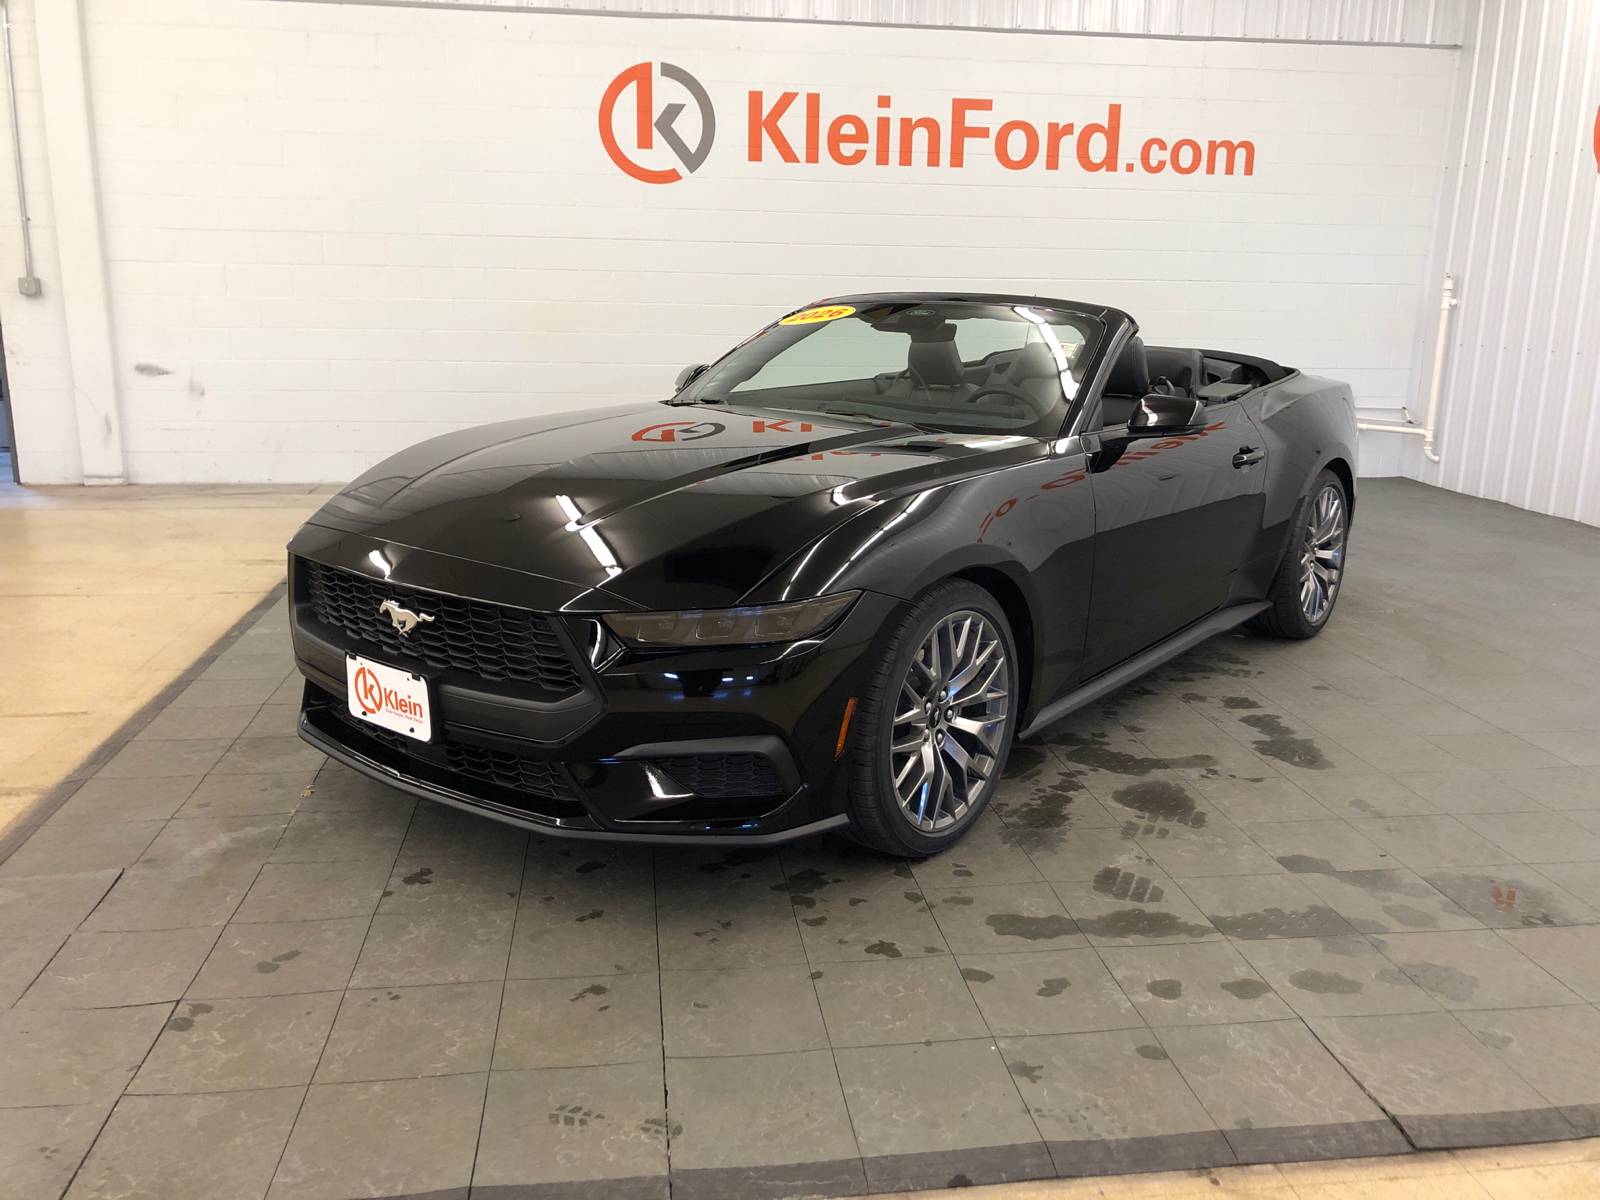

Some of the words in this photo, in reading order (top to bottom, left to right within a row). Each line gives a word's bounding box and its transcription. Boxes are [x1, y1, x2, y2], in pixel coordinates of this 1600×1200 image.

[747, 90, 1255, 176] KleinFord.com
[785, 308, 848, 323] 2026
[384, 687, 423, 718] Klein
